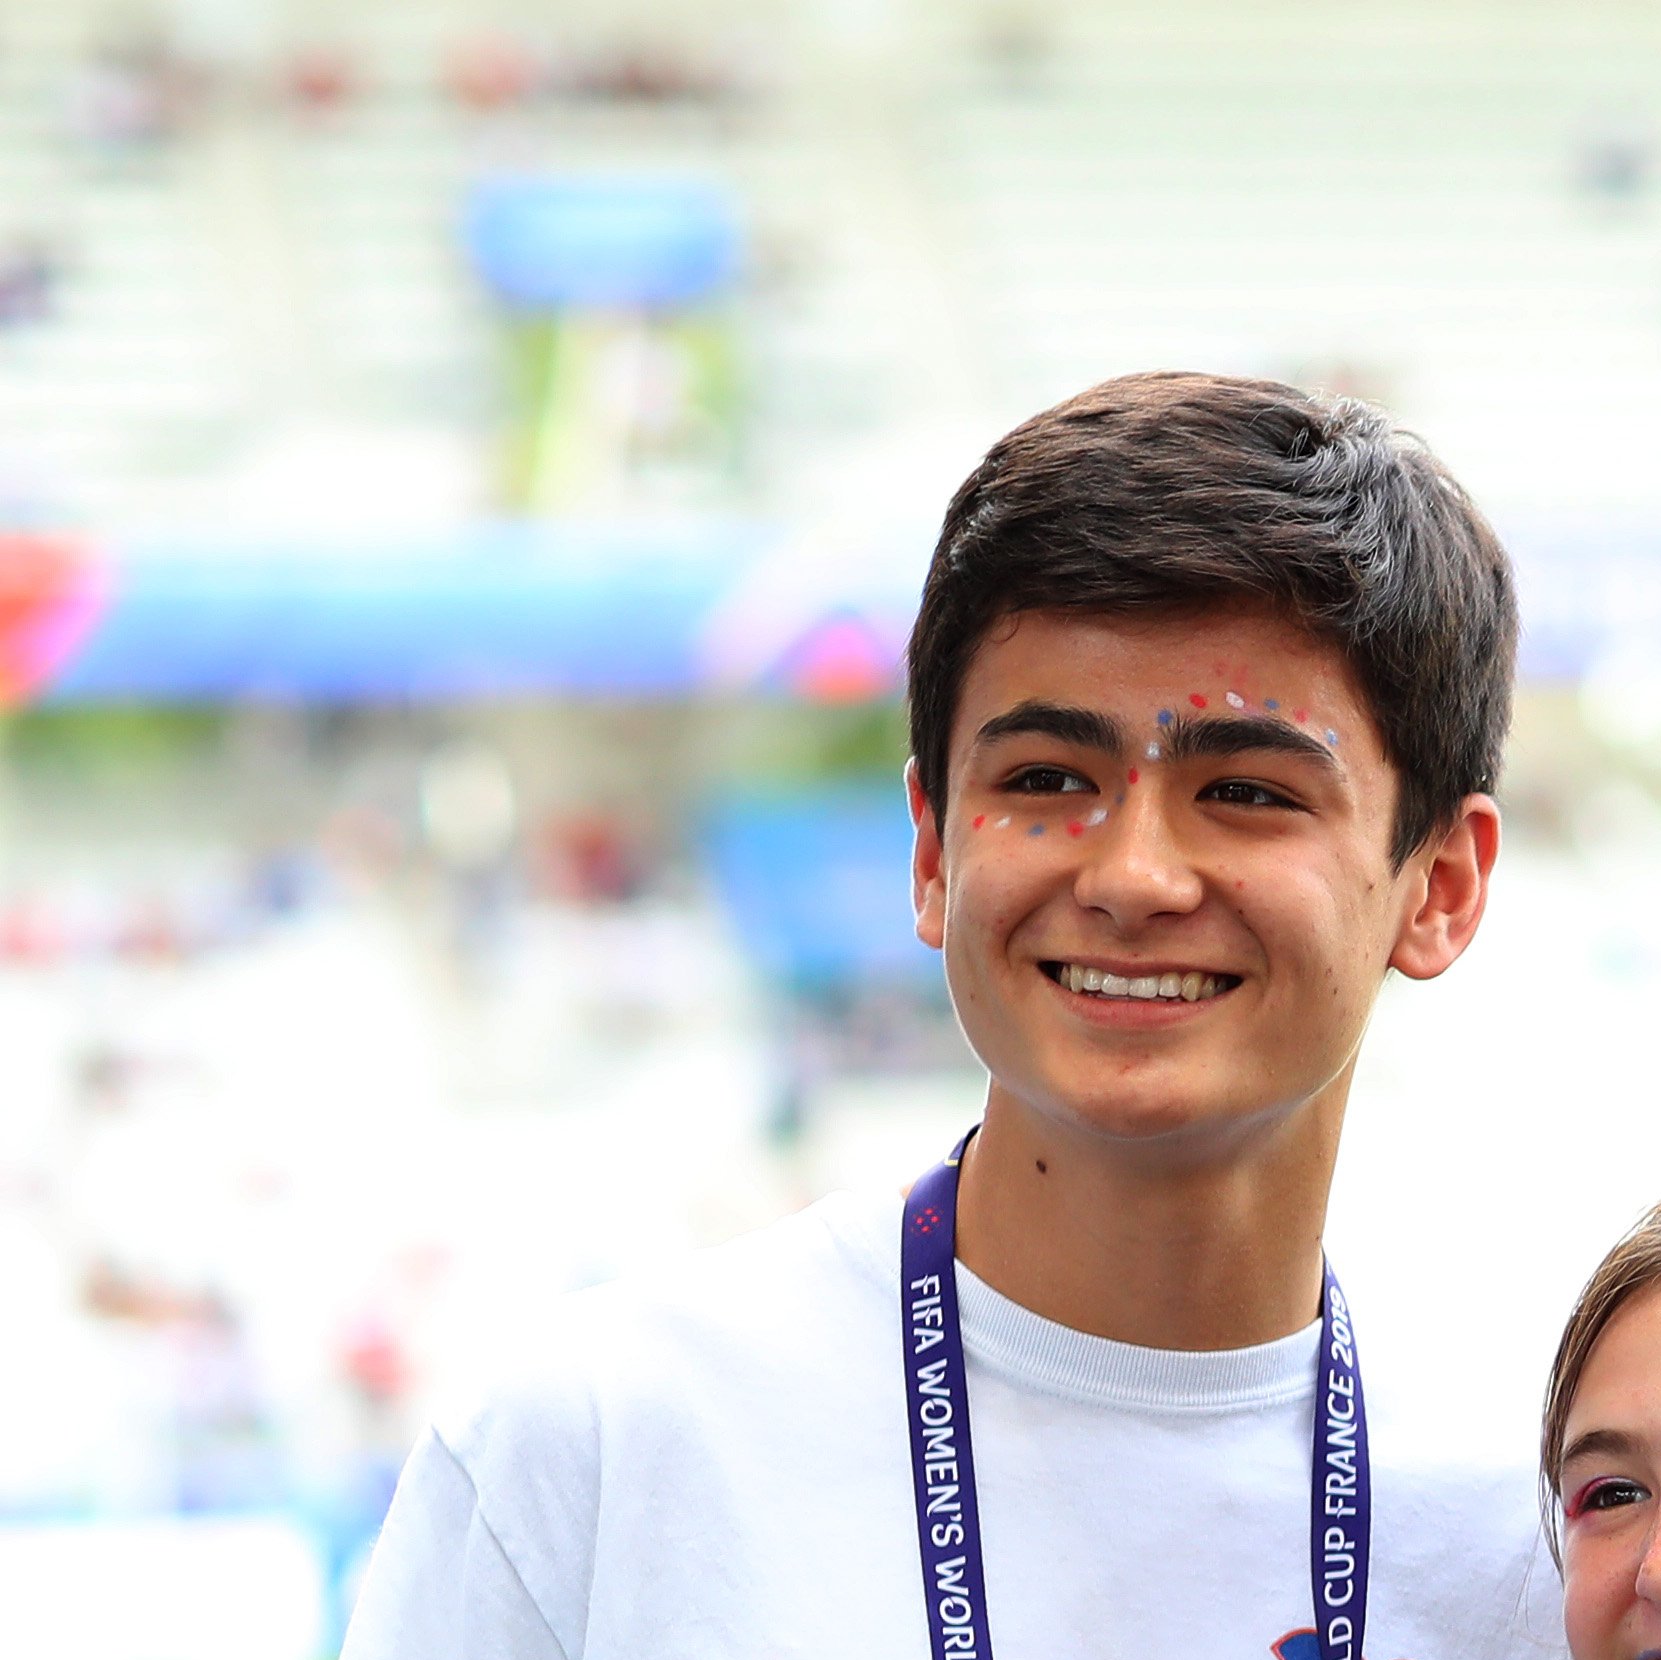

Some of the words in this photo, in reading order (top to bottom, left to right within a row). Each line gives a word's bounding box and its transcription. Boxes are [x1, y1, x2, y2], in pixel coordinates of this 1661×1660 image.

[909, 1272, 946, 1356] FIFA
[1329, 1286, 1354, 1370] 2019
[916, 1357, 965, 1550] WOMEN'S
[1324, 1368, 1359, 1520] FRANCE
[1323, 1525, 1357, 1609] CUP
